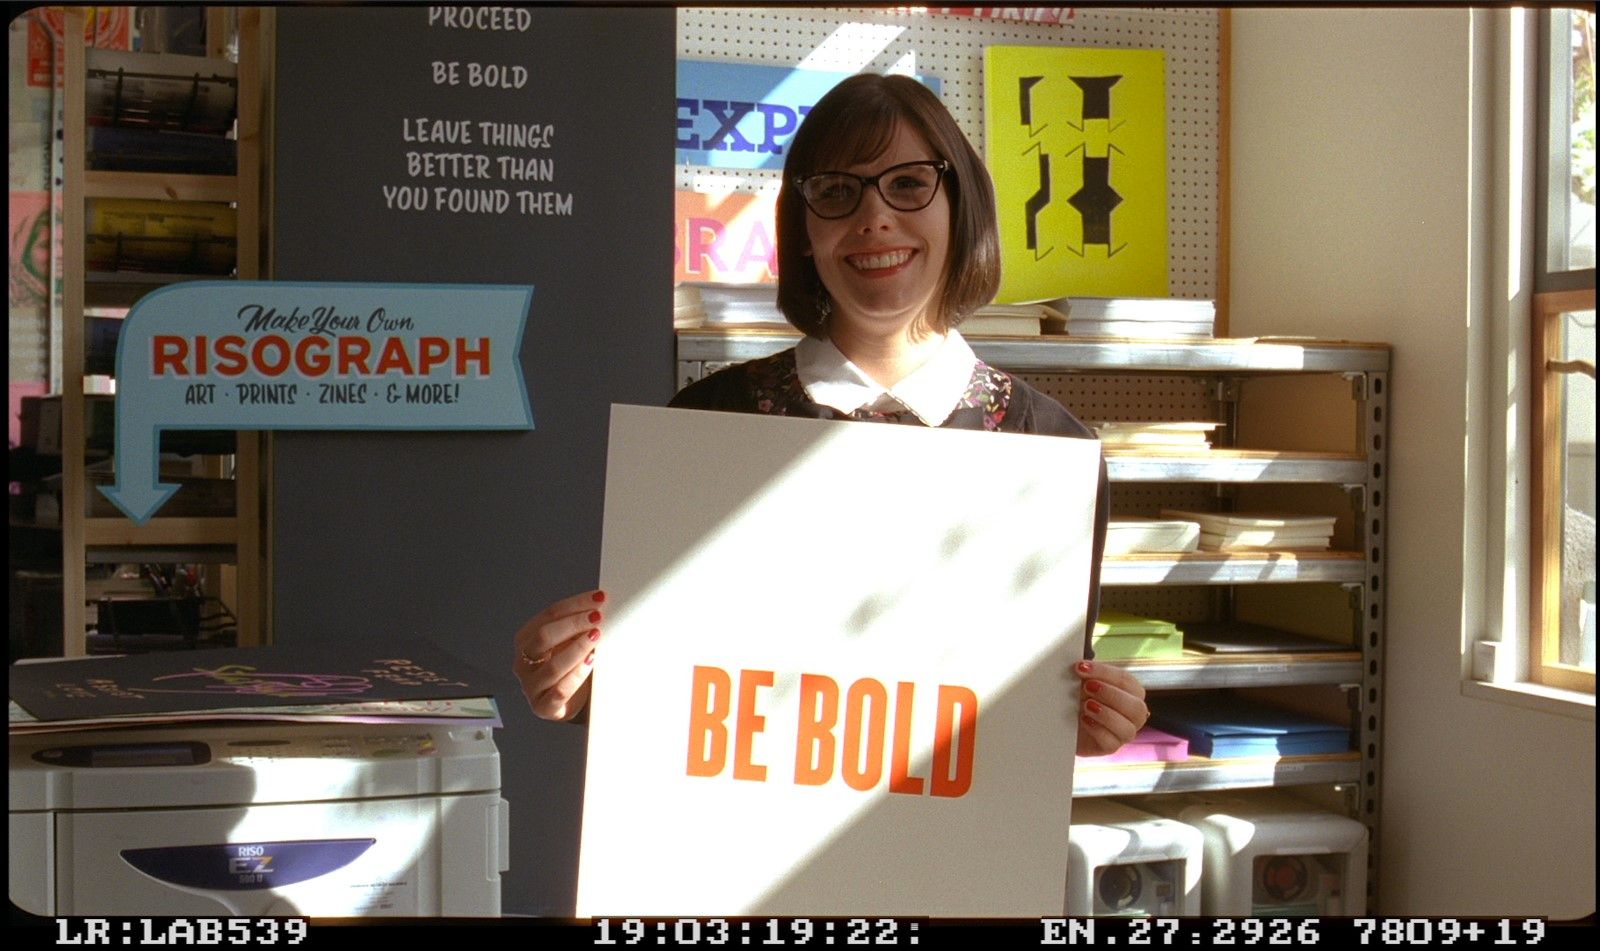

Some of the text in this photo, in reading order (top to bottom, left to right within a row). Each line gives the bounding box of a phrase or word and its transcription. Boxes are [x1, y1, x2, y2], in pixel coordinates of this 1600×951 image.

[428, 6, 532, 32] PROCEED
[431, 61, 528, 89] BE BOLD
[403, 117, 554, 148] LEAVE THINGS
[676, 98, 814, 155] EXP
[406, 151, 554, 182] BETTER THAN
[382, 185, 574, 215] YOU FOUND THEM
[237, 304, 415, 337] Make Your Own
[150, 334, 491, 380] RISOGRAPH
[185, 383, 460, 405] ART PRINTS ZINES & MORE!
[686, 665, 978, 799] BE BOLD
[229, 856, 274, 874] EZ
[238, 845, 265, 857] RISO
